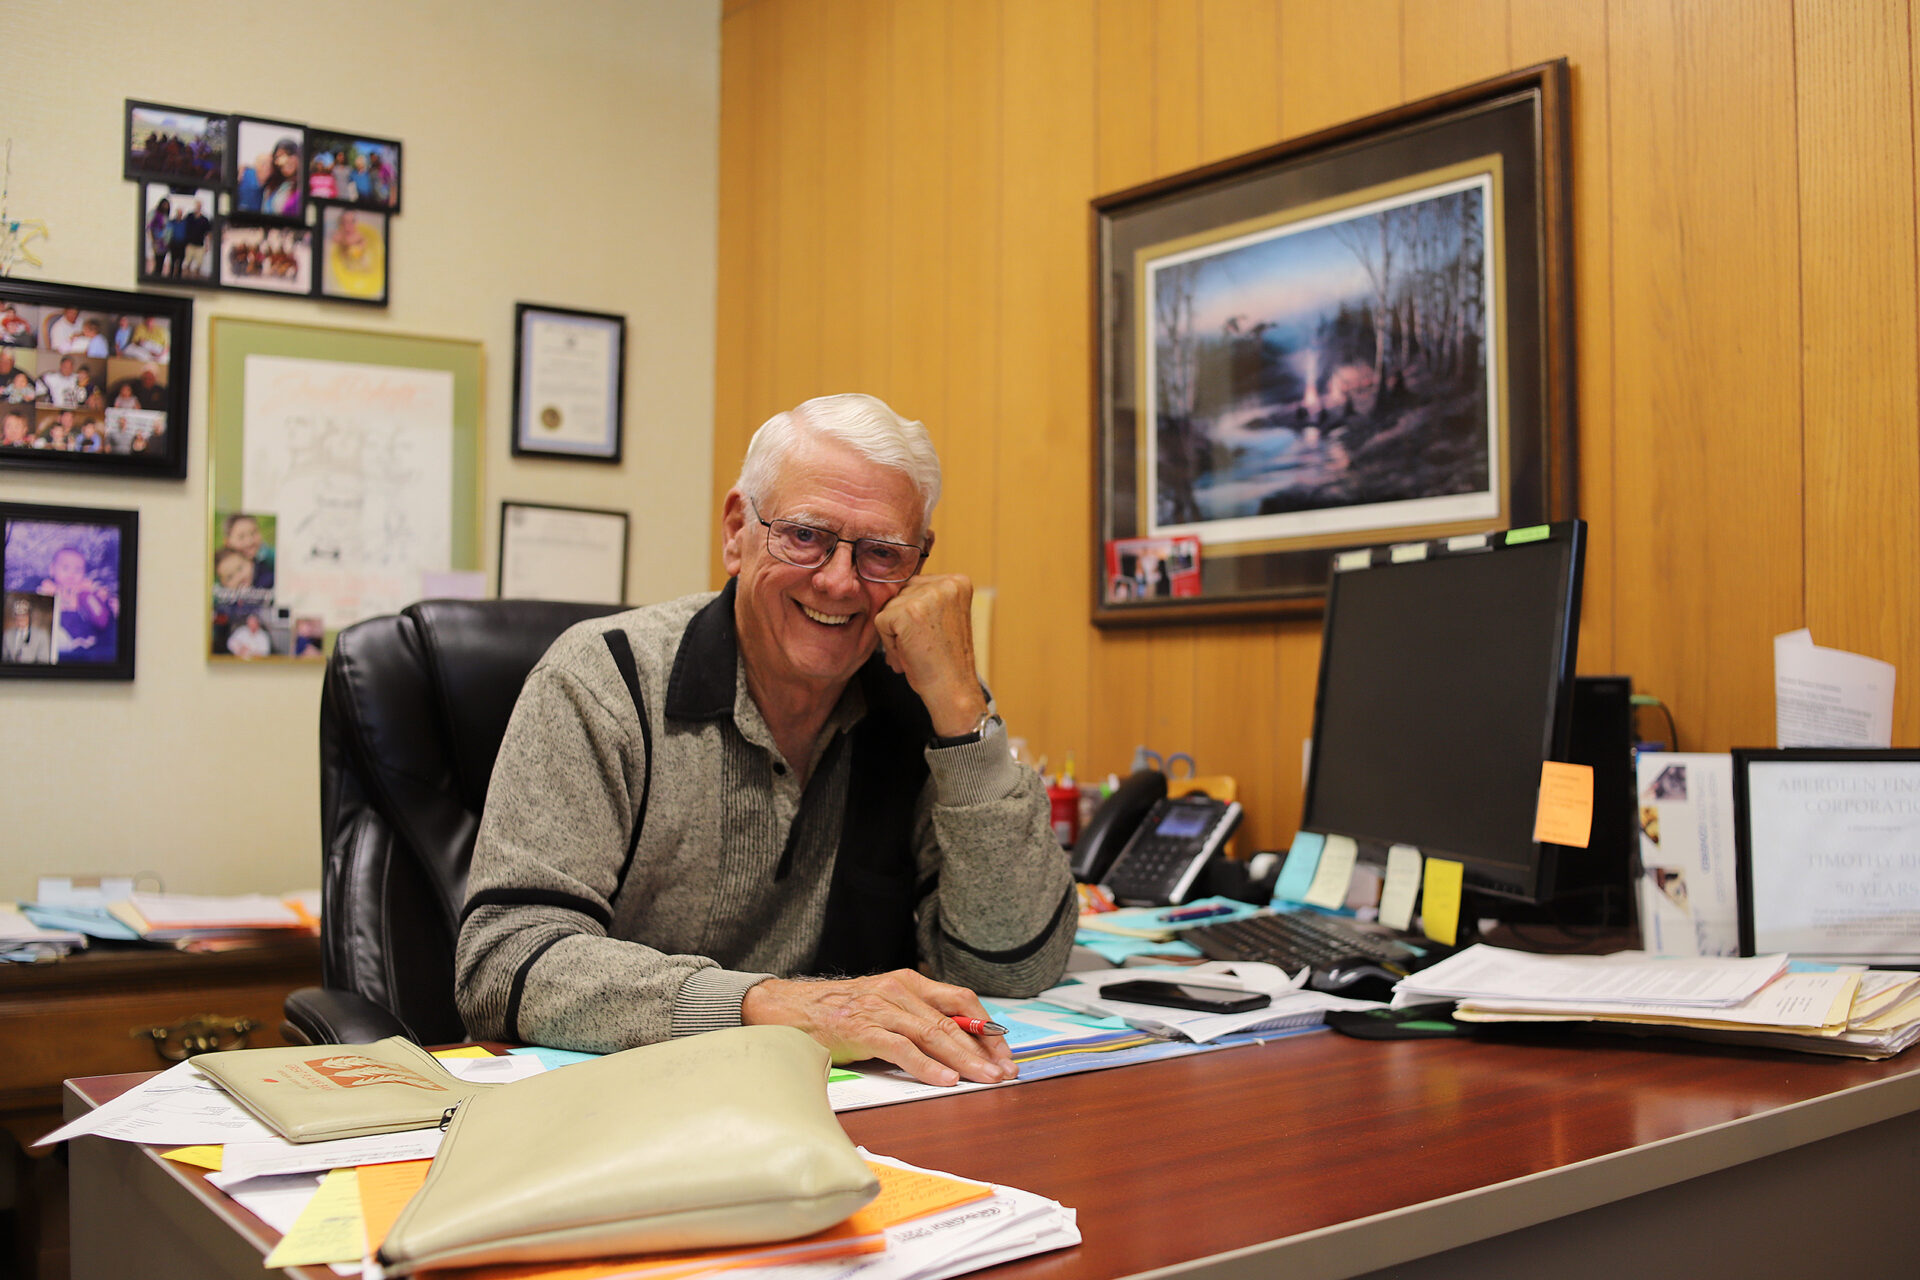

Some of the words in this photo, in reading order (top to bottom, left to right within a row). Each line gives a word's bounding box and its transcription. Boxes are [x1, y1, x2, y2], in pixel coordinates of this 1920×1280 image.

[1778, 776, 1876, 793] ABERDEEN
[1809, 853, 1890, 868] TIMOTHY
[1861, 881, 1918, 897] YEARS
